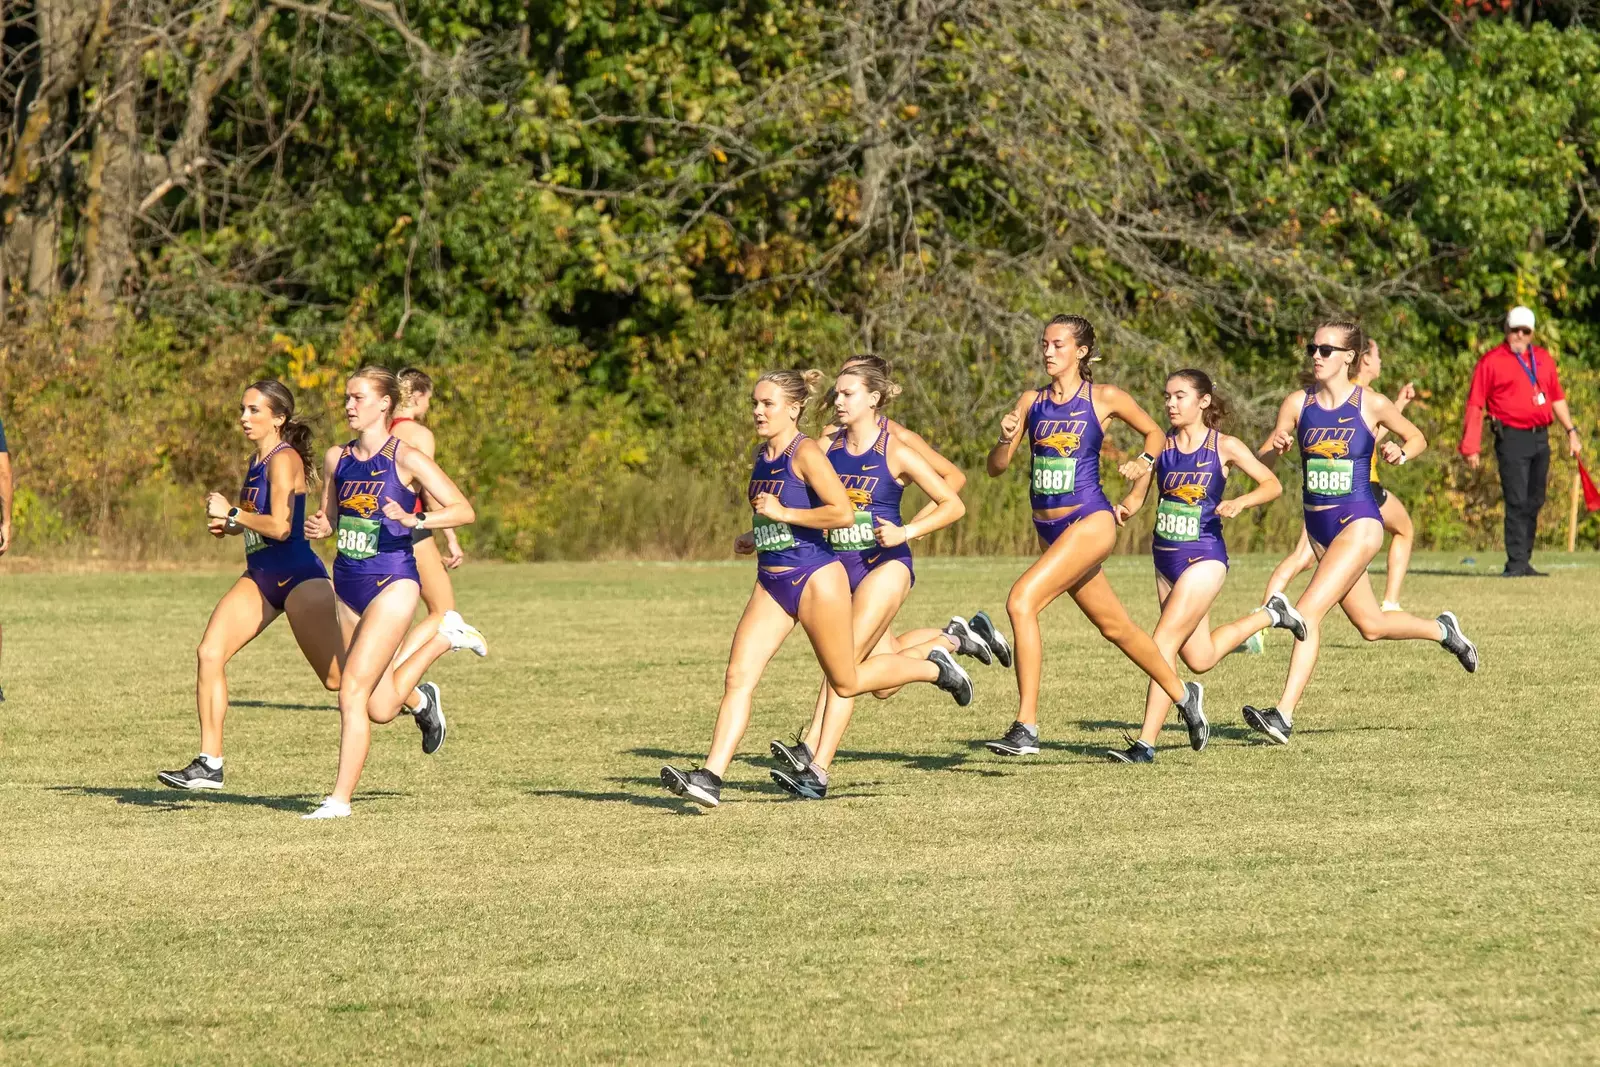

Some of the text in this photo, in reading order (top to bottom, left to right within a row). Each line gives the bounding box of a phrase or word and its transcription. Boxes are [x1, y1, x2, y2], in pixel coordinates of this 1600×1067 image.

[1034, 420, 1088, 441] UNI
[1303, 428, 1356, 449] UNI
[1035, 469, 1072, 490] 3887
[1163, 472, 1213, 491] UNI
[1308, 471, 1351, 490] 3885
[339, 481, 385, 501] UNI
[754, 522, 791, 547] 3883
[1158, 513, 1198, 536] 3888
[337, 528, 377, 553] 3882
